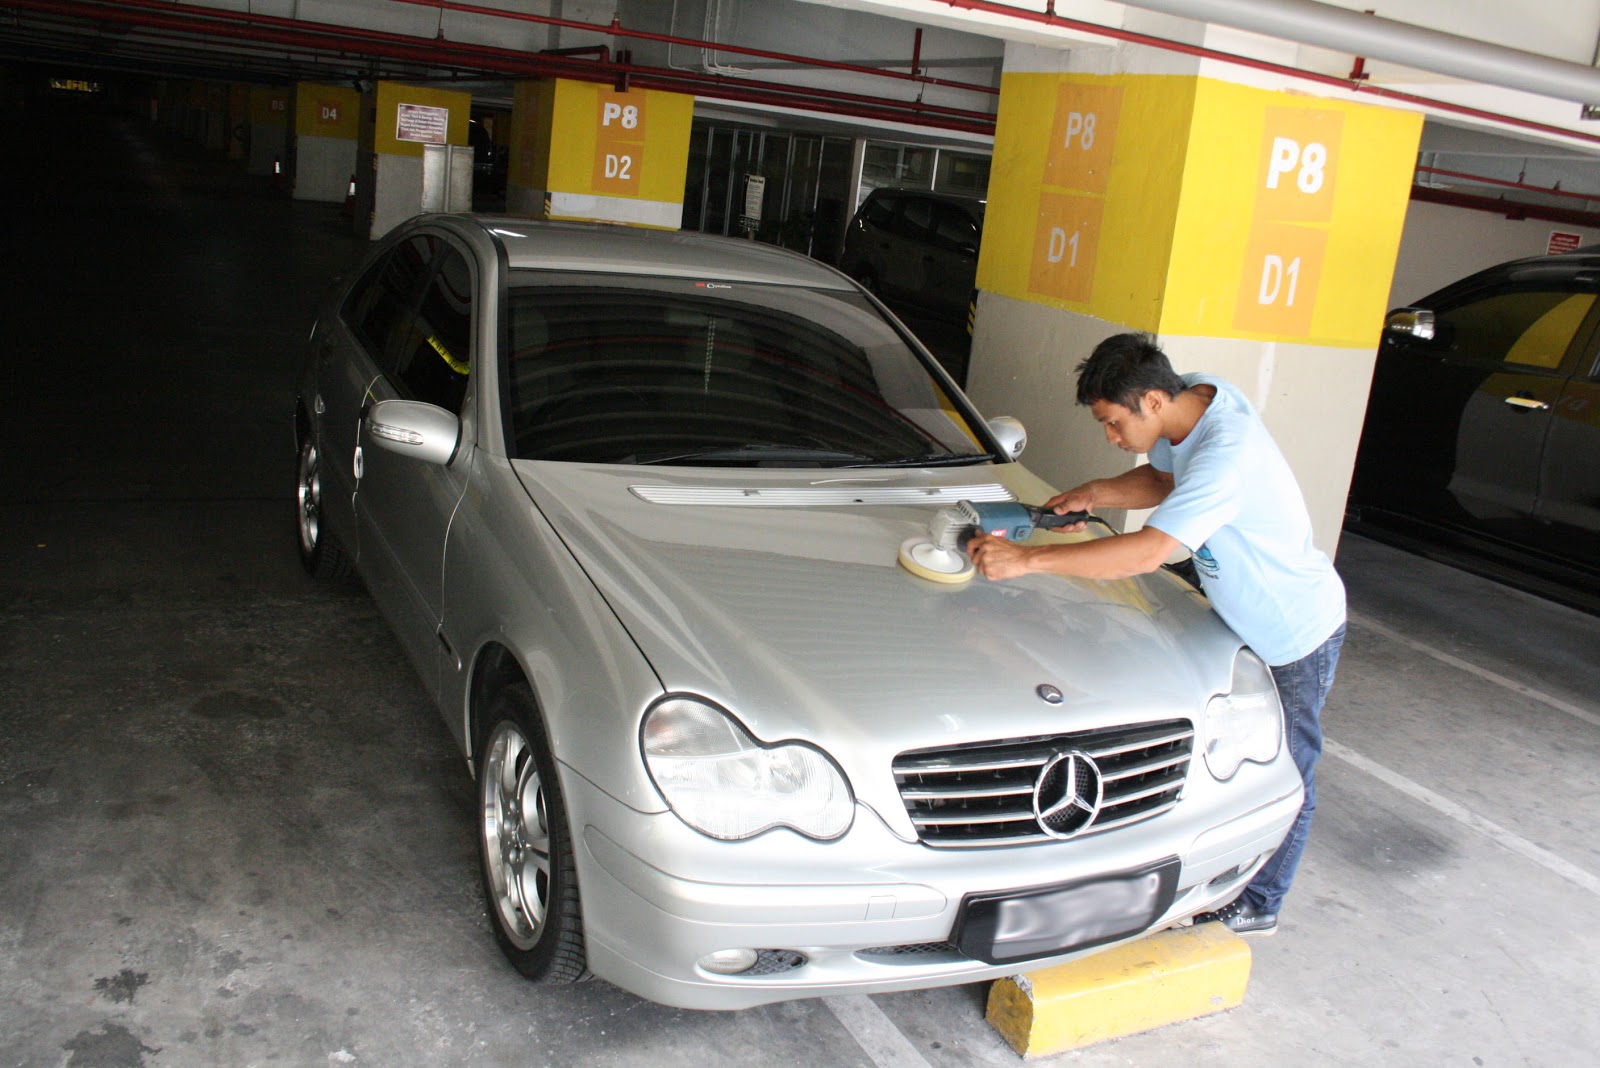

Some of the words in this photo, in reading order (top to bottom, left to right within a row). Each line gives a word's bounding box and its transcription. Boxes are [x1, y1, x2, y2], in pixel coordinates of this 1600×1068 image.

[323, 107, 337, 120] D4
[602, 102, 638, 129] P8
[1064, 112, 1096, 150] P8
[604, 154, 632, 180] D2
[1266, 136, 1327, 194] P8
[1048, 227, 1080, 267] D1
[1258, 254, 1301, 306] D1
[1237, 917, 1255, 925] Dior
